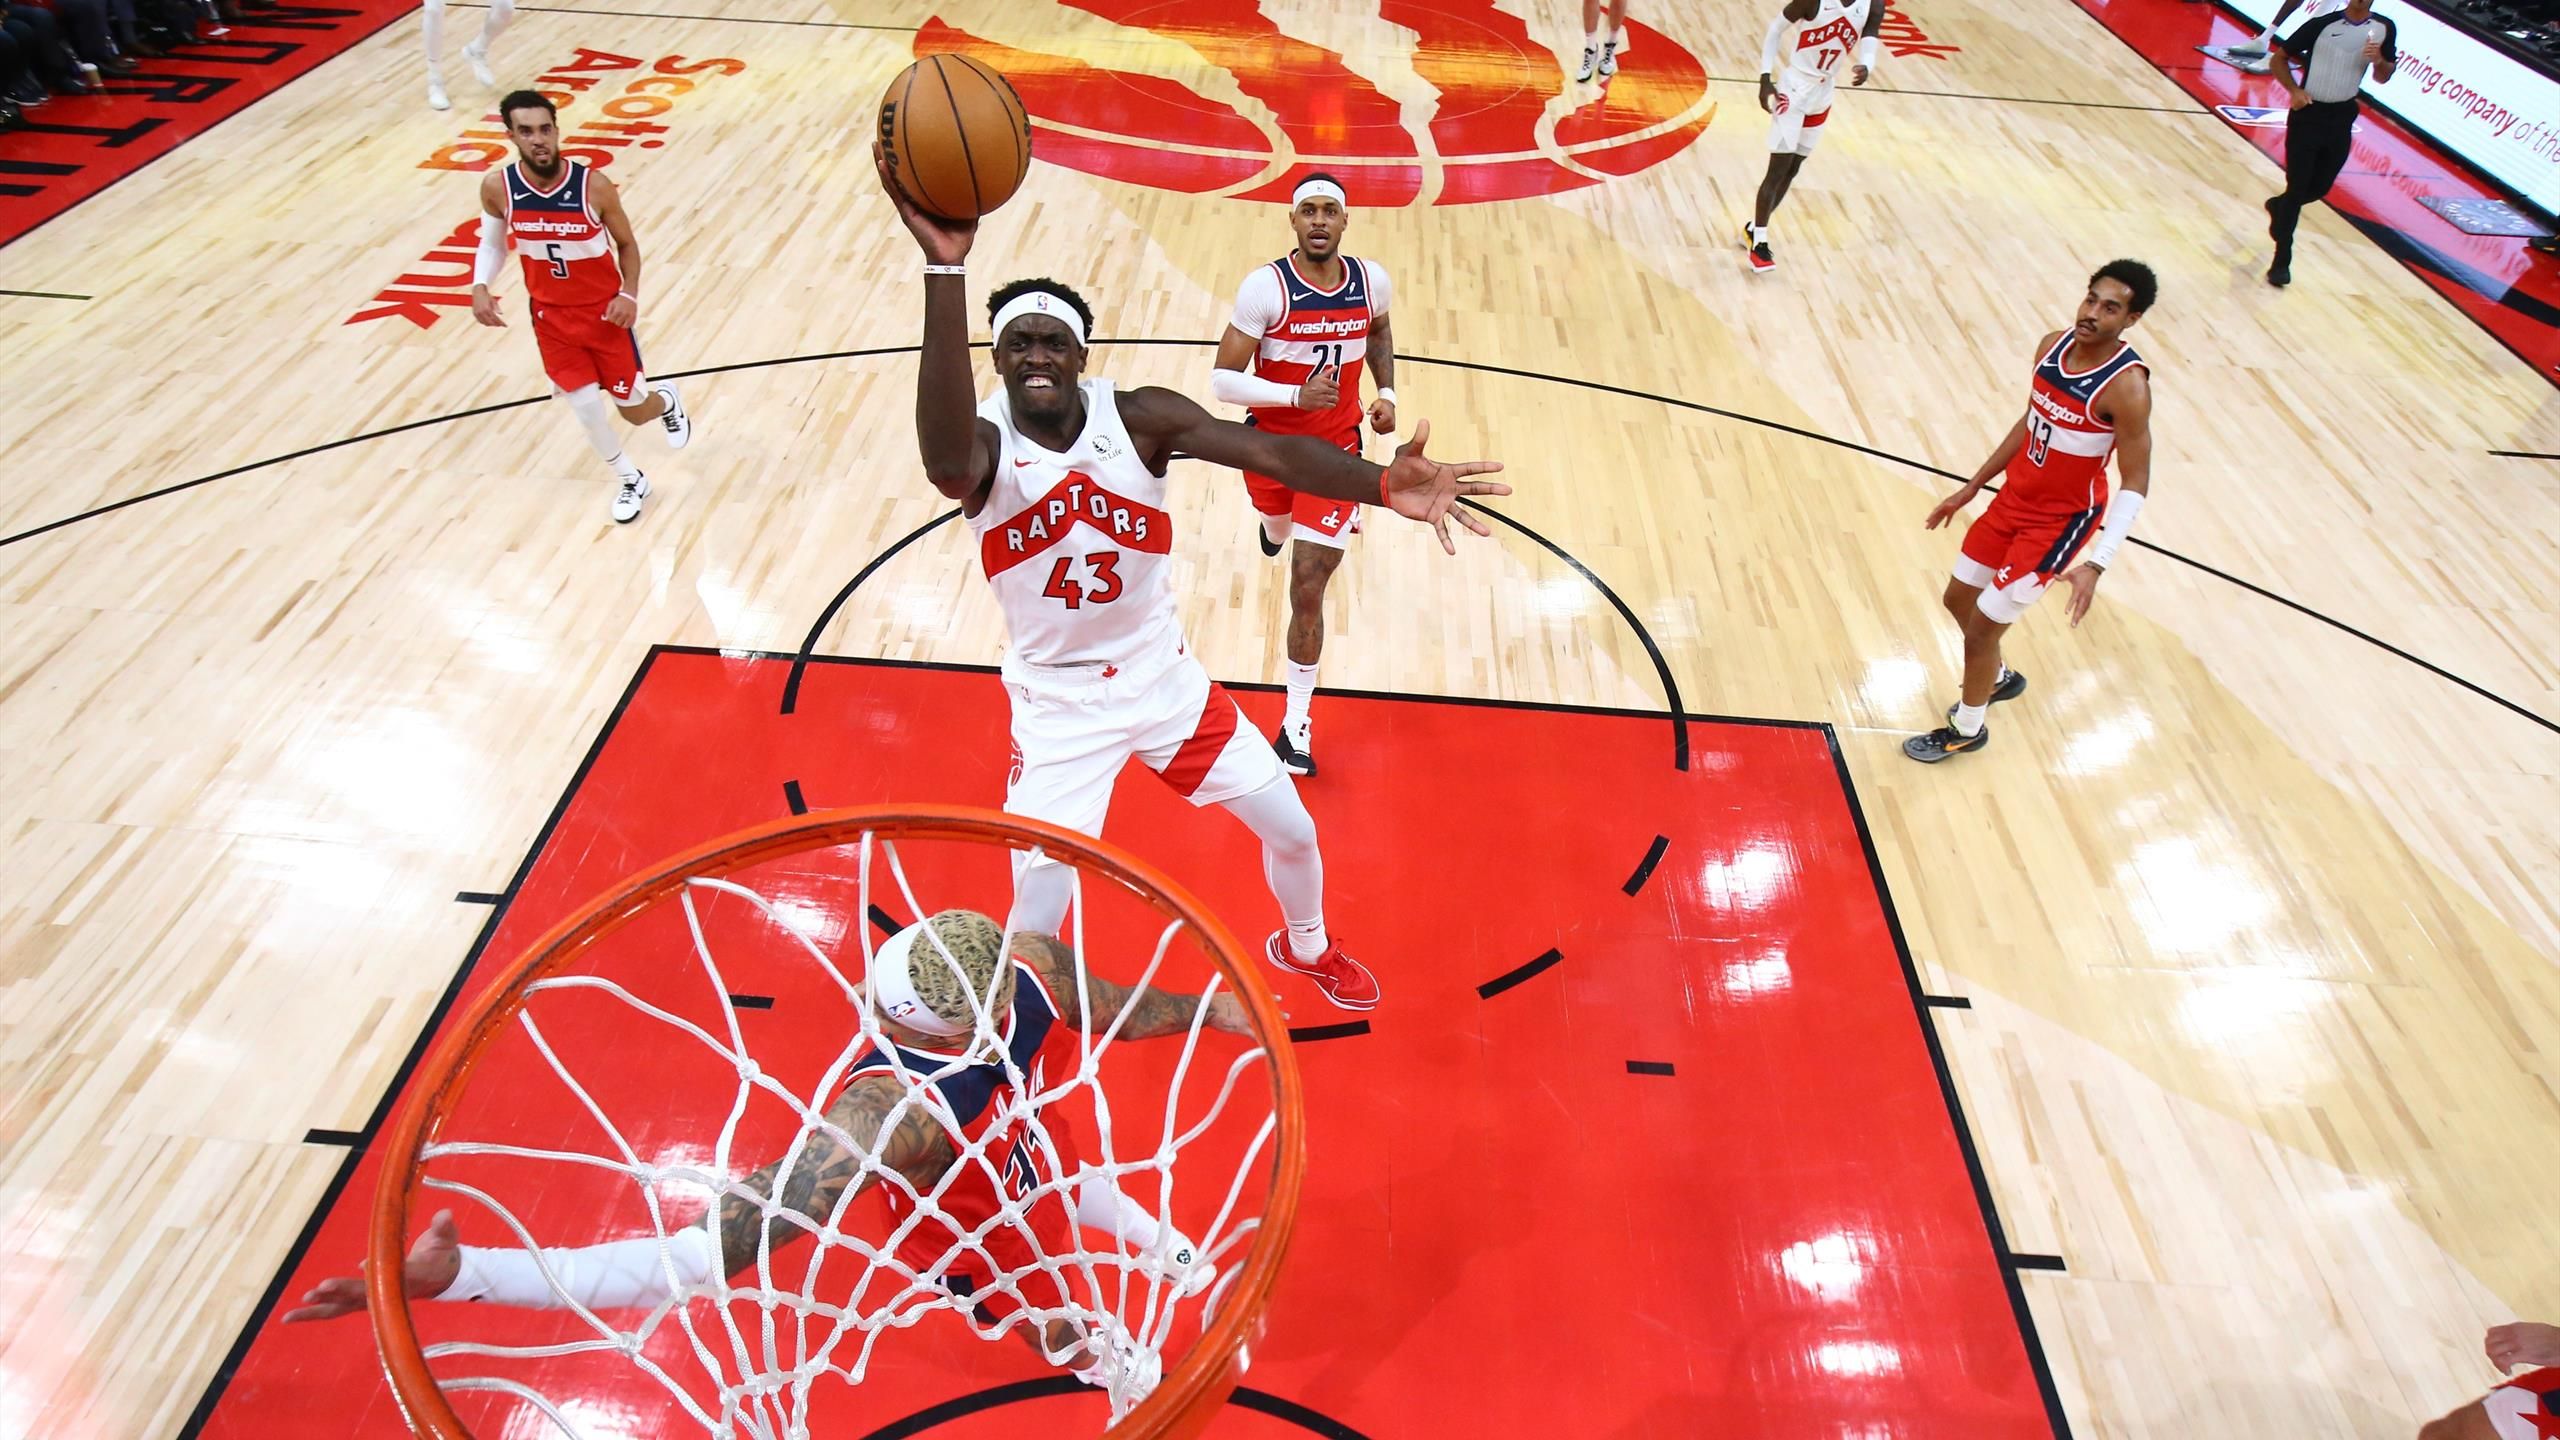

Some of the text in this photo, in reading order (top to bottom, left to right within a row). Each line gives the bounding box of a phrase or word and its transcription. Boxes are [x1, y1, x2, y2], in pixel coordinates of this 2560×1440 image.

[1878, 0, 1962, 61] ank
[1817, 48, 1842, 71] 17
[2440, 79, 2519, 137] company
[2513, 121, 2546, 144] of
[343, 54, 746, 329] Scotiaank
[512, 217, 588, 236] washington
[546, 243, 570, 279] 5
[1290, 316, 1367, 336] washington
[1306, 343, 1343, 383] 21
[2031, 389, 2085, 425] ashington
[2027, 415, 2053, 468] 13
[1006, 483, 1148, 553] RAPTORS
[1041, 550, 1124, 610] 43
